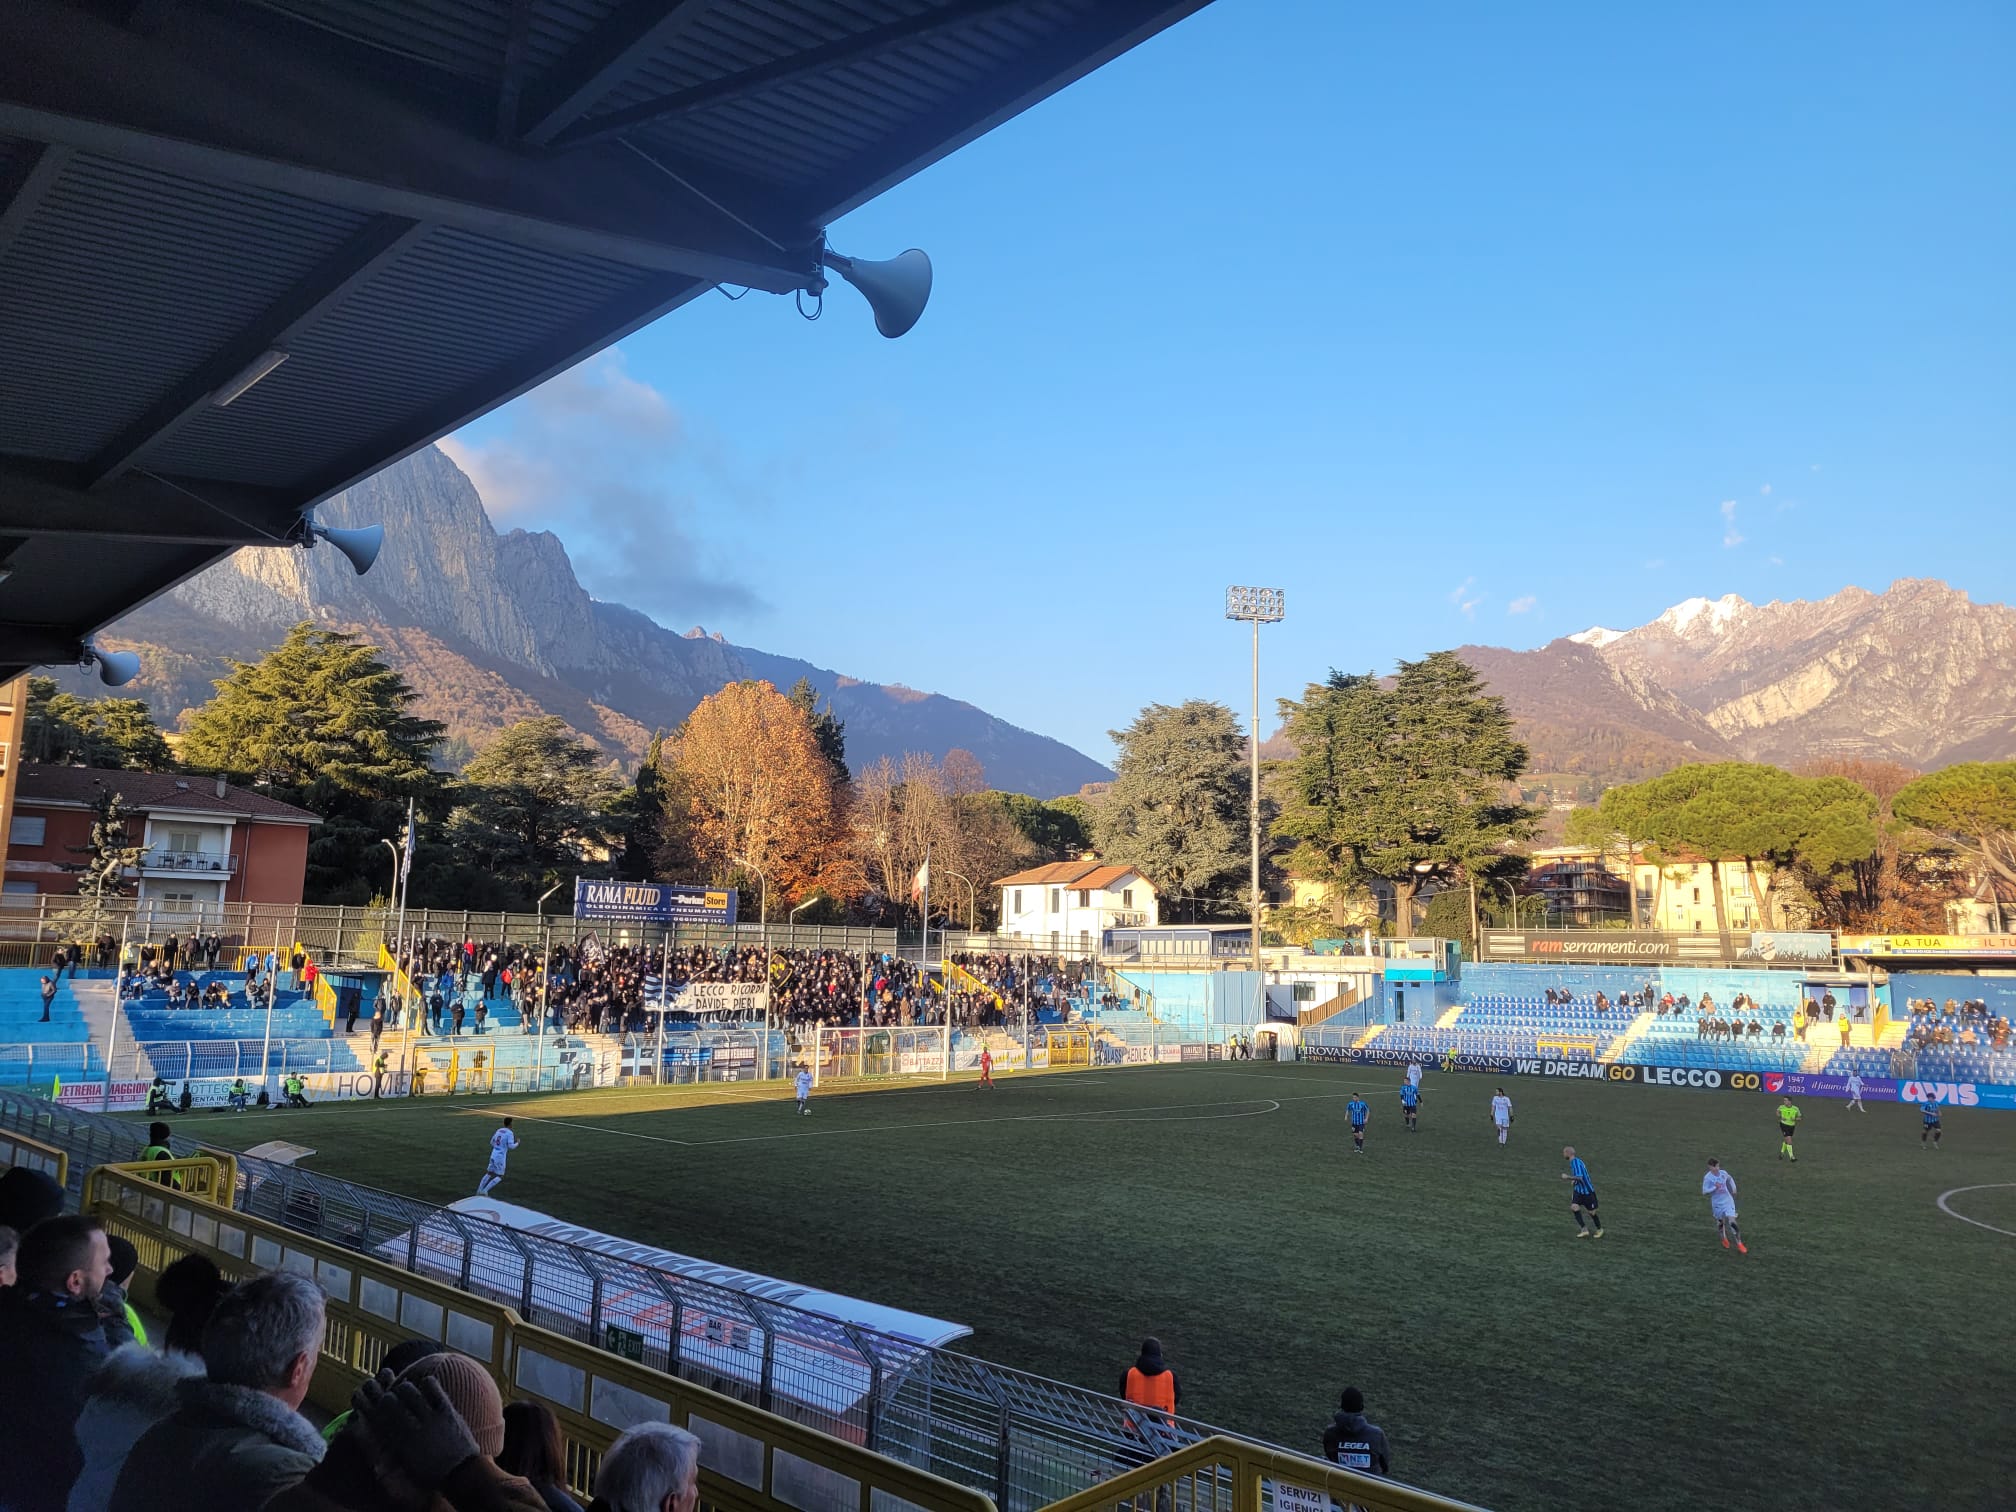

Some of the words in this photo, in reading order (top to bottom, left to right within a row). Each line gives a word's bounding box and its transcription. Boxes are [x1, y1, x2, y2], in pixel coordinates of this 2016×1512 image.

[586, 885, 621, 903] RAMA
[623, 887, 660, 906] FLUID
[706, 896, 726, 905] Store
[1532, 940, 1670, 954] ramserramenti.com
[1895, 938, 1911, 947] LA
[1916, 938, 1941, 947] TUA
[1984, 938, 1996, 947] IL
[693, 985, 725, 996] LECCO
[731, 984, 765, 995] RICORDA
[695, 998, 726, 1010] DAVIDE
[1298, 1046, 1361, 1058] PIROVANO
[1365, 1049, 1434, 1062] PIROVANO
[1438, 1054, 1512, 1068] PIROVANO
[1516, 1059, 1541, 1075] WE
[1544, 1061, 1604, 1080] DREAM
[1609, 1065, 1636, 1081] GO
[1643, 1067, 1722, 1088] LECCO
[1730, 1073, 1760, 1090] GO
[1787, 1075, 1805, 1084] 1947
[60, 1085, 102, 1097] VETRERIA
[1787, 1085, 1806, 1094] 2022
[1901, 1081, 1980, 1106] AVIS
[708, 1319, 722, 1329] BAR
[1338, 1442, 1370, 1450] LEGEA
[1280, 1484, 1321, 1504] SERVIZI
